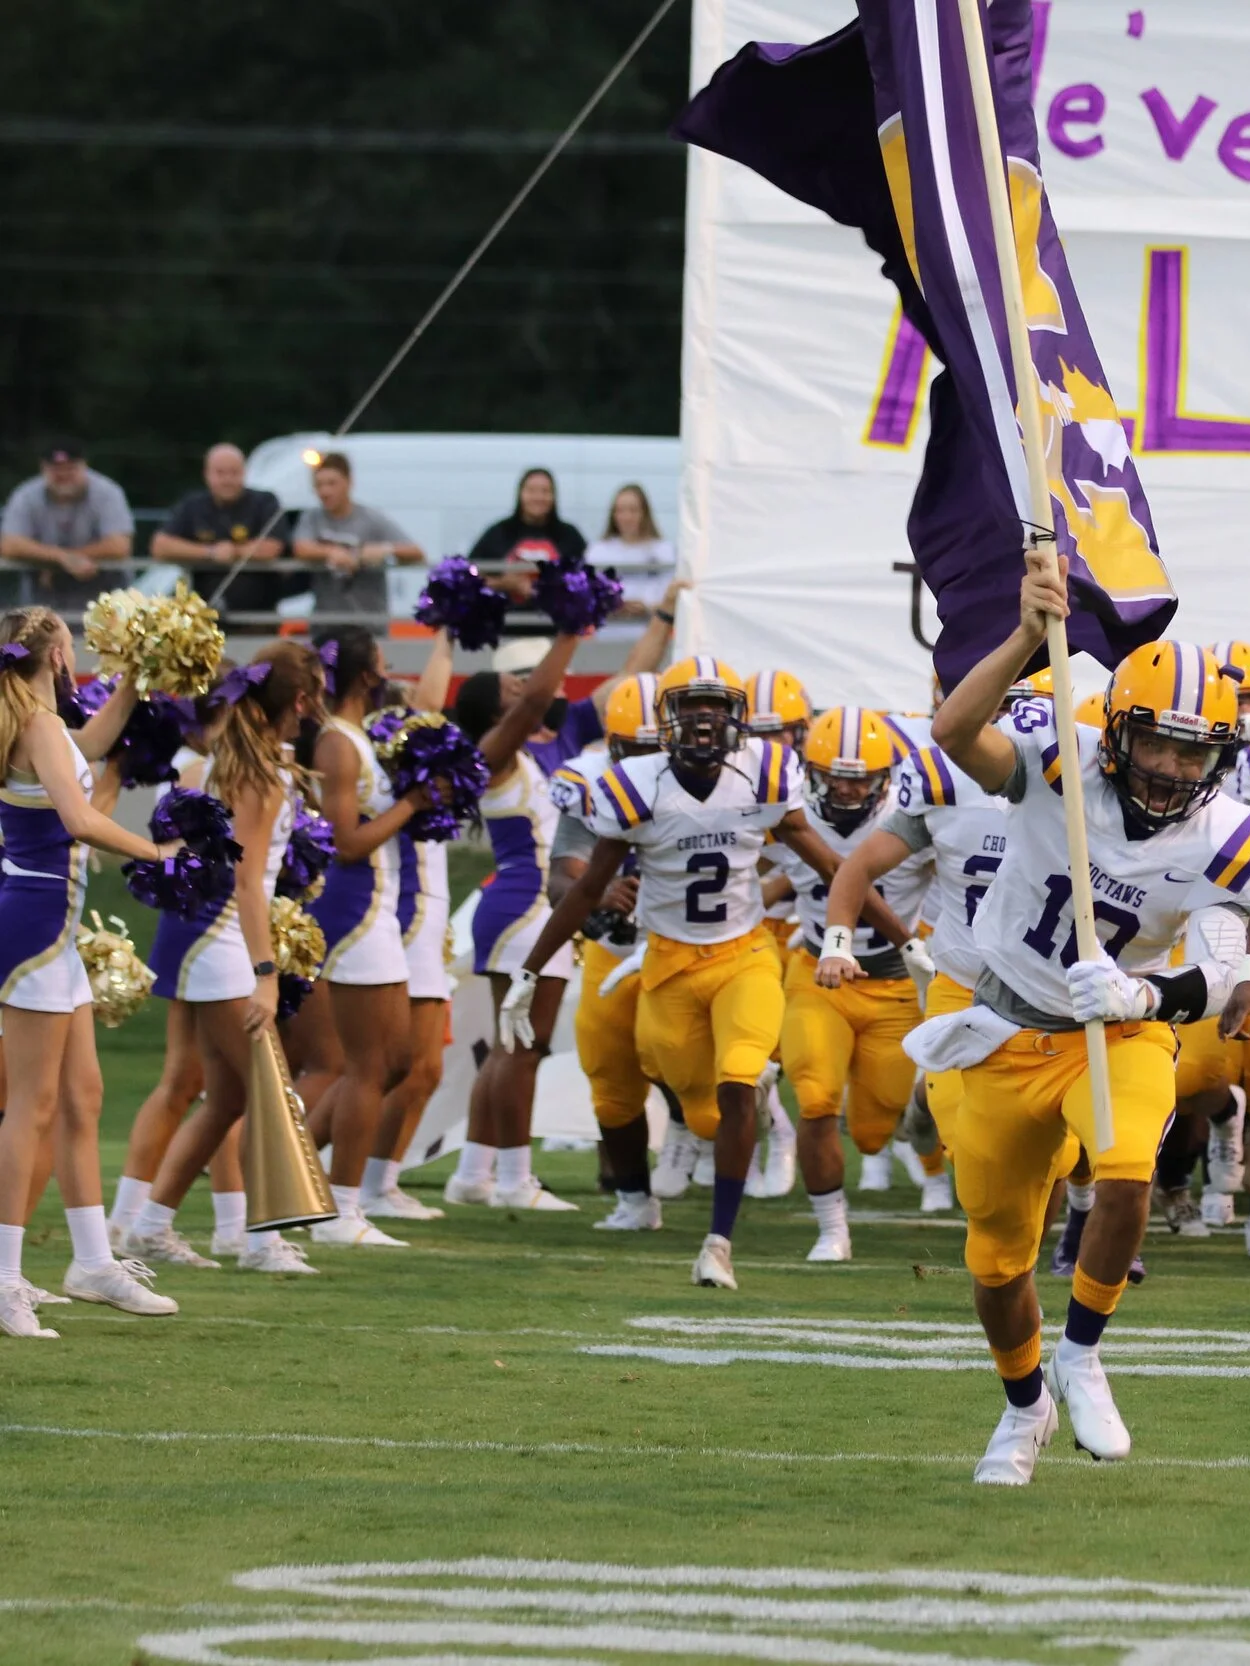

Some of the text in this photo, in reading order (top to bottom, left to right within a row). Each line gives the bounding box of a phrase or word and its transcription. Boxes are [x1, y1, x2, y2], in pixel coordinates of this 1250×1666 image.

[1170, 714, 1199, 727] Riddell
[676, 831, 737, 851] CHOCTAWS
[686, 852, 730, 923] 2
[1068, 862, 1147, 909] OCTAWS
